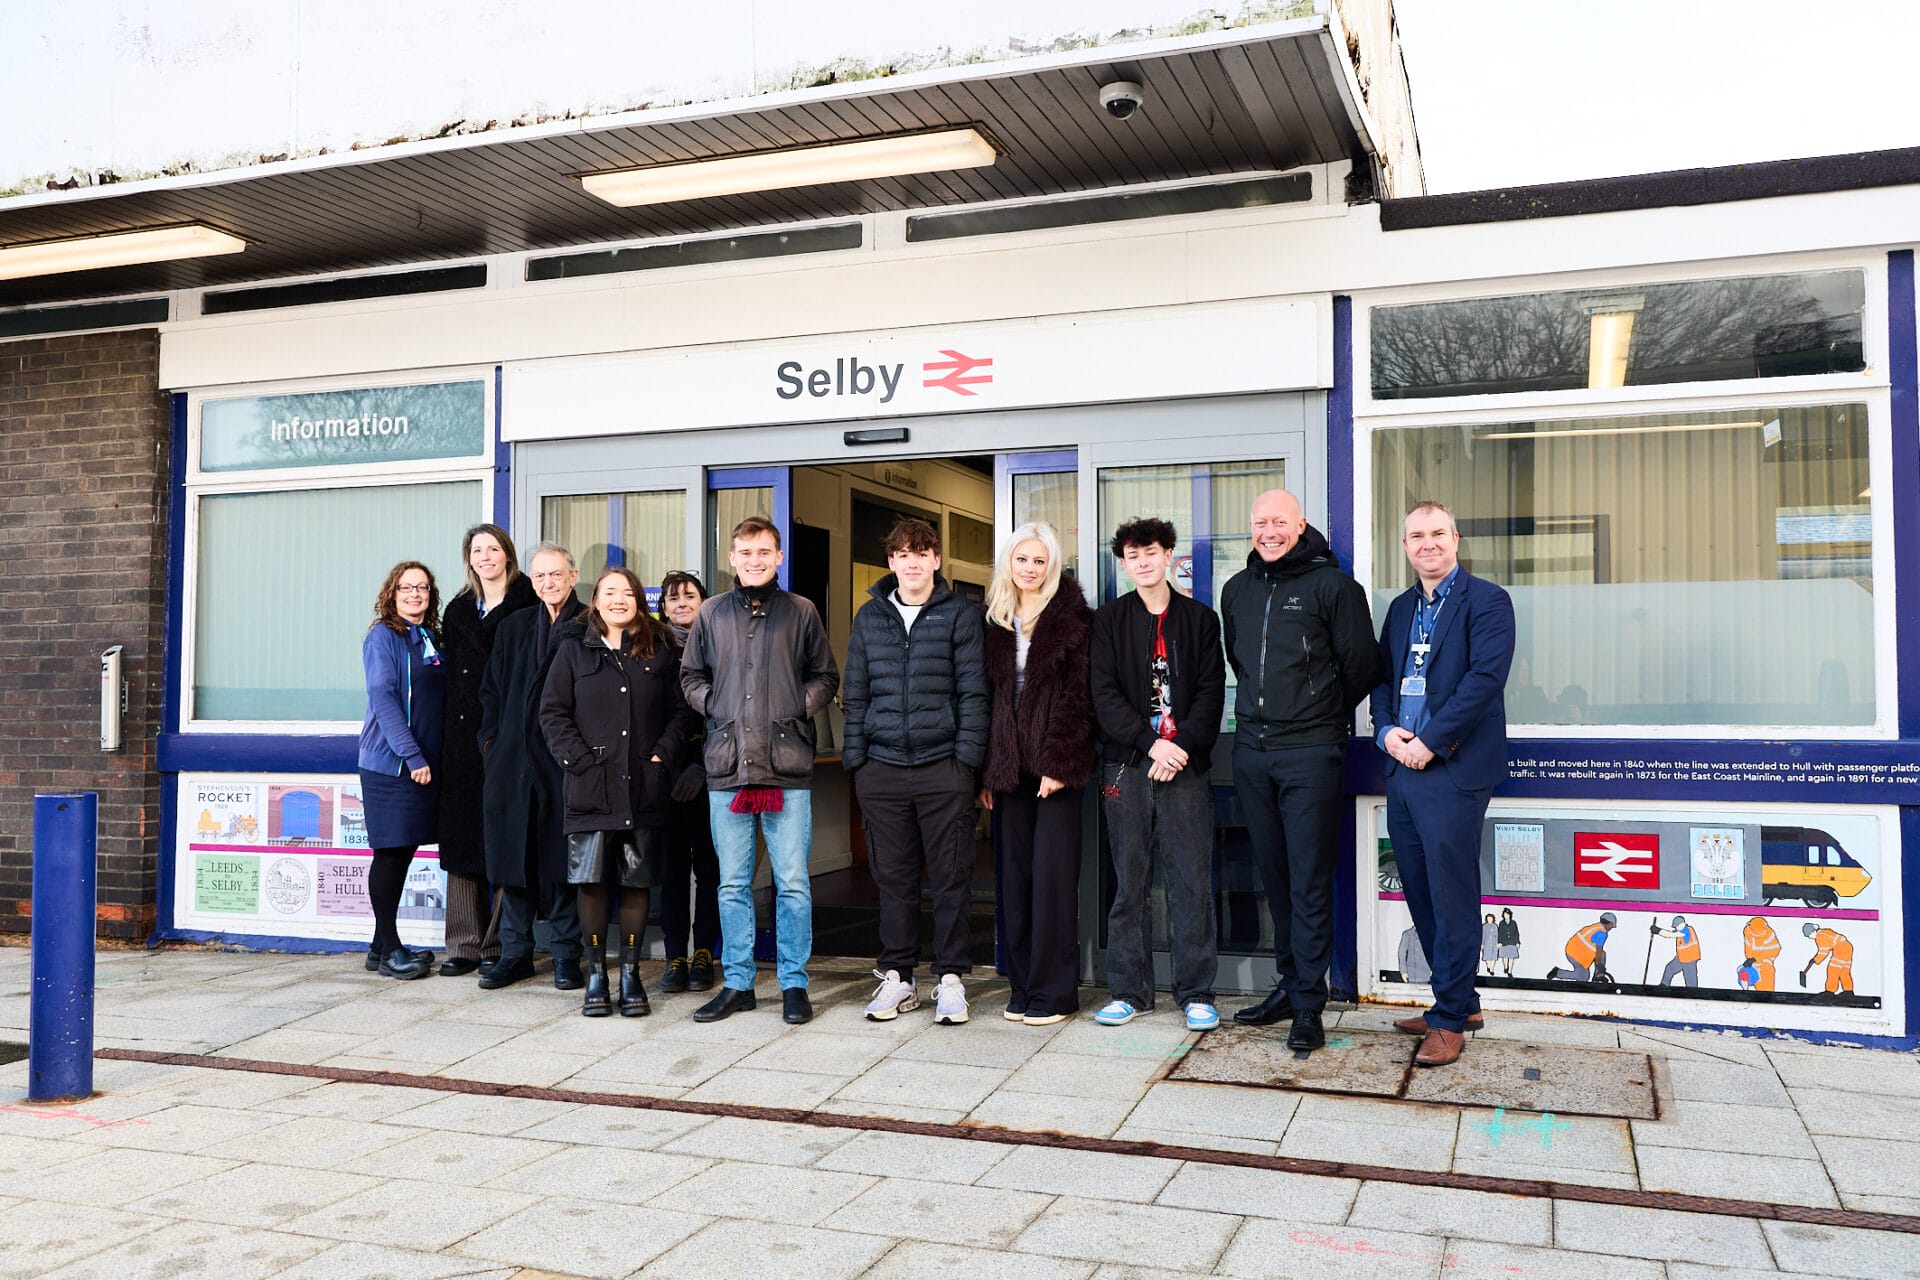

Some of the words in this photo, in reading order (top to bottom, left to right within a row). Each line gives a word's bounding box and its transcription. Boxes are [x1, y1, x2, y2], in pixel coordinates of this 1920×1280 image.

[776, 357, 904, 403] Selby
[271, 413, 409, 441] Information
[1517, 758, 1537, 767] built
[1539, 759, 1556, 768] and
[1558, 759, 1588, 768] moved
[1590, 760, 1611, 768] here
[1613, 760, 1622, 768] in
[1623, 760, 1645, 769] 1840
[1646, 760, 1673, 769] when
[1674, 761, 1690, 769] the
[1692, 760, 1709, 770] line
[1711, 762, 1730, 770] was
[1731, 761, 1777, 770] extended
[1779, 762, 1791, 771] to
[1792, 762, 1811, 771] Hull
[1812, 762, 1835, 772] with
[1837, 764, 1889, 773] passenger
[1510, 769, 1538, 778] traffic.
[1540, 770, 1547, 778] It
[1547, 771, 1566, 779] was
[1567, 770, 1597, 779] rebuilt
[1598, 770, 1624, 781] again
[1625, 770, 1635, 779] in
[1636, 771, 1657, 780] 1873
[1658, 771, 1672, 780] for
[1673, 771, 1690, 780] the
[1691, 772, 1711, 781] East
[1713, 772, 1742, 781] Coast
[1743, 772, 1785, 783] Mainline,
[1786, 773, 1806, 782] and
[1807, 774, 1835, 784] again
[1836, 773, 1846, 783] in
[1847, 774, 1869, 783] 1891
[1870, 774, 1886, 783] for
[198, 792, 252, 803] ROCKET
[344, 834, 369, 845] 1839
[211, 862, 243, 874] LEEDS
[332, 865, 366, 878] SELBY
[211, 879, 243, 891] SELBY
[250, 870, 258, 891] 1834
[335, 883, 365, 895] HULL
